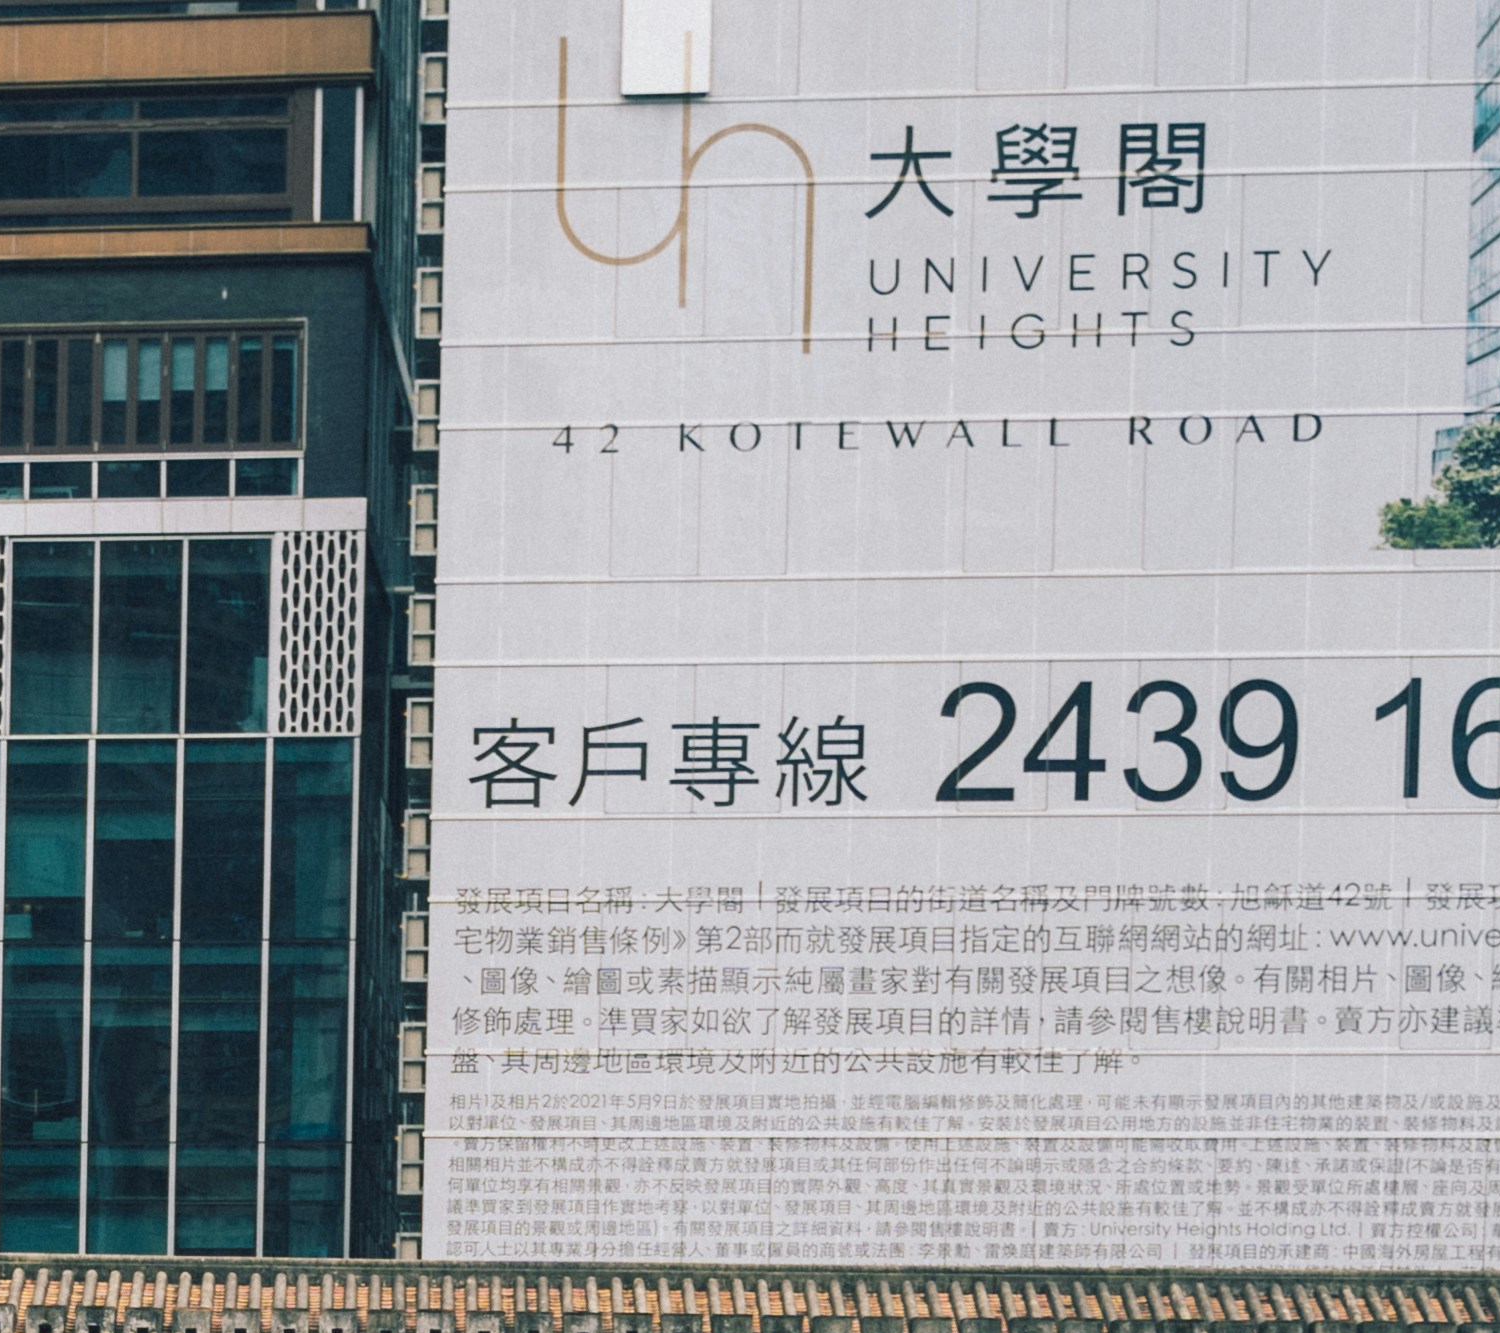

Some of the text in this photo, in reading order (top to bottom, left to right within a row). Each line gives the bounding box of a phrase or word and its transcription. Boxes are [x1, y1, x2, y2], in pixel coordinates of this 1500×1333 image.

[864, 121, 1207, 220] 大學閣
[868, 249, 1334, 297] UNIVERSITY
[867, 310, 1198, 353] HEIGHTS
[551, 411, 1325, 455] 42 KOTEWALL ROAD
[468, 714, 870, 809] 客戶專線
[934, 677, 1301, 804] 2439
[1091, 1222, 1173, 1240] University
[1176, 1222, 1242, 1240] Heights
[1246, 1222, 1316, 1240] Holding
[1320, 1222, 1352, 1238] Ltd.
